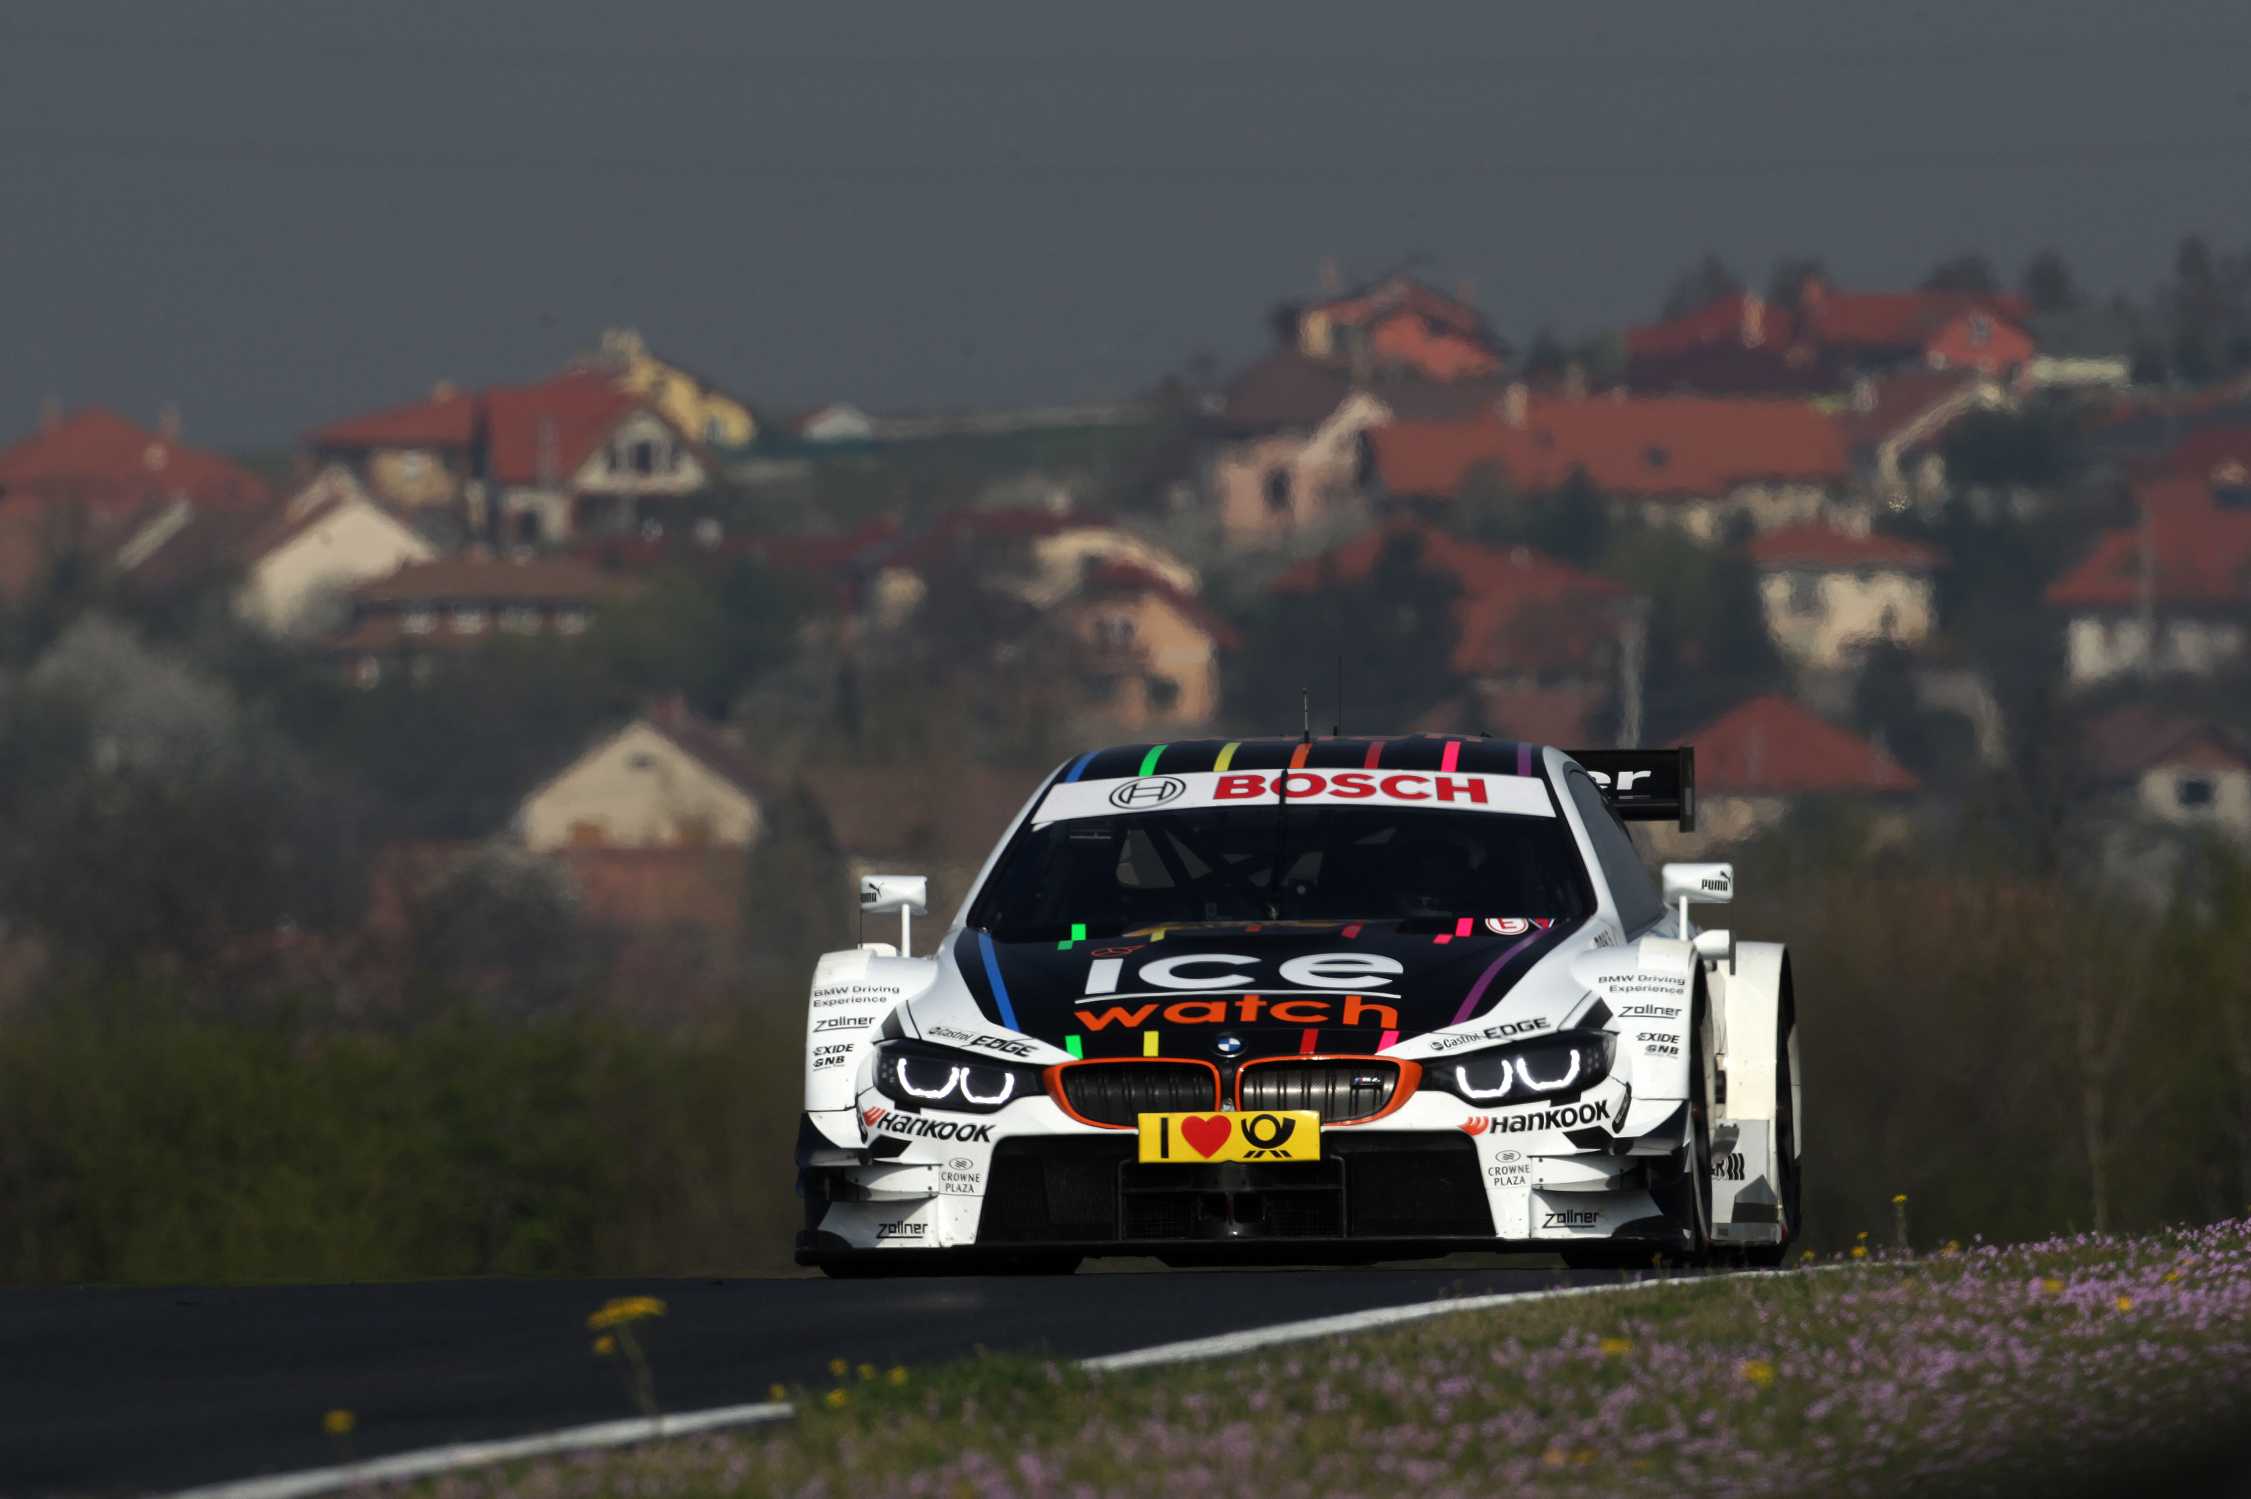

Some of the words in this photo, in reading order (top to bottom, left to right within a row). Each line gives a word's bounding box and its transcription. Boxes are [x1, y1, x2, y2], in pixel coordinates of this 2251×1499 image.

[1213, 773, 1489, 804] BOSCH
[1701, 879, 1728, 891] PUMA
[1085, 952, 1404, 995] ice
[1598, 974, 1635, 983] BMW
[1638, 974, 1685, 986] Driving
[814, 986, 848, 997] BMW
[852, 984, 900, 994] Driving
[1609, 984, 1685, 994] Experience
[813, 996, 887, 1008] Experience
[1074, 995, 1398, 1032] watch
[1443, 1033, 1481, 1049] Castrol
[1483, 1017, 1551, 1040] EDGE
[1636, 1032, 1680, 1044] EXIDE
[813, 1043, 855, 1056] EXIDE
[939, 1028, 974, 1041] Castrol
[970, 1035, 1040, 1058] EDGE
[1160, 1117, 1169, 1159] I
[1487, 1164, 1531, 1177] CROWNE
[940, 1172, 981, 1184] CROWNE
[1493, 1176, 1526, 1187] PLAZA
[945, 1183, 975, 1193] PLAZA
